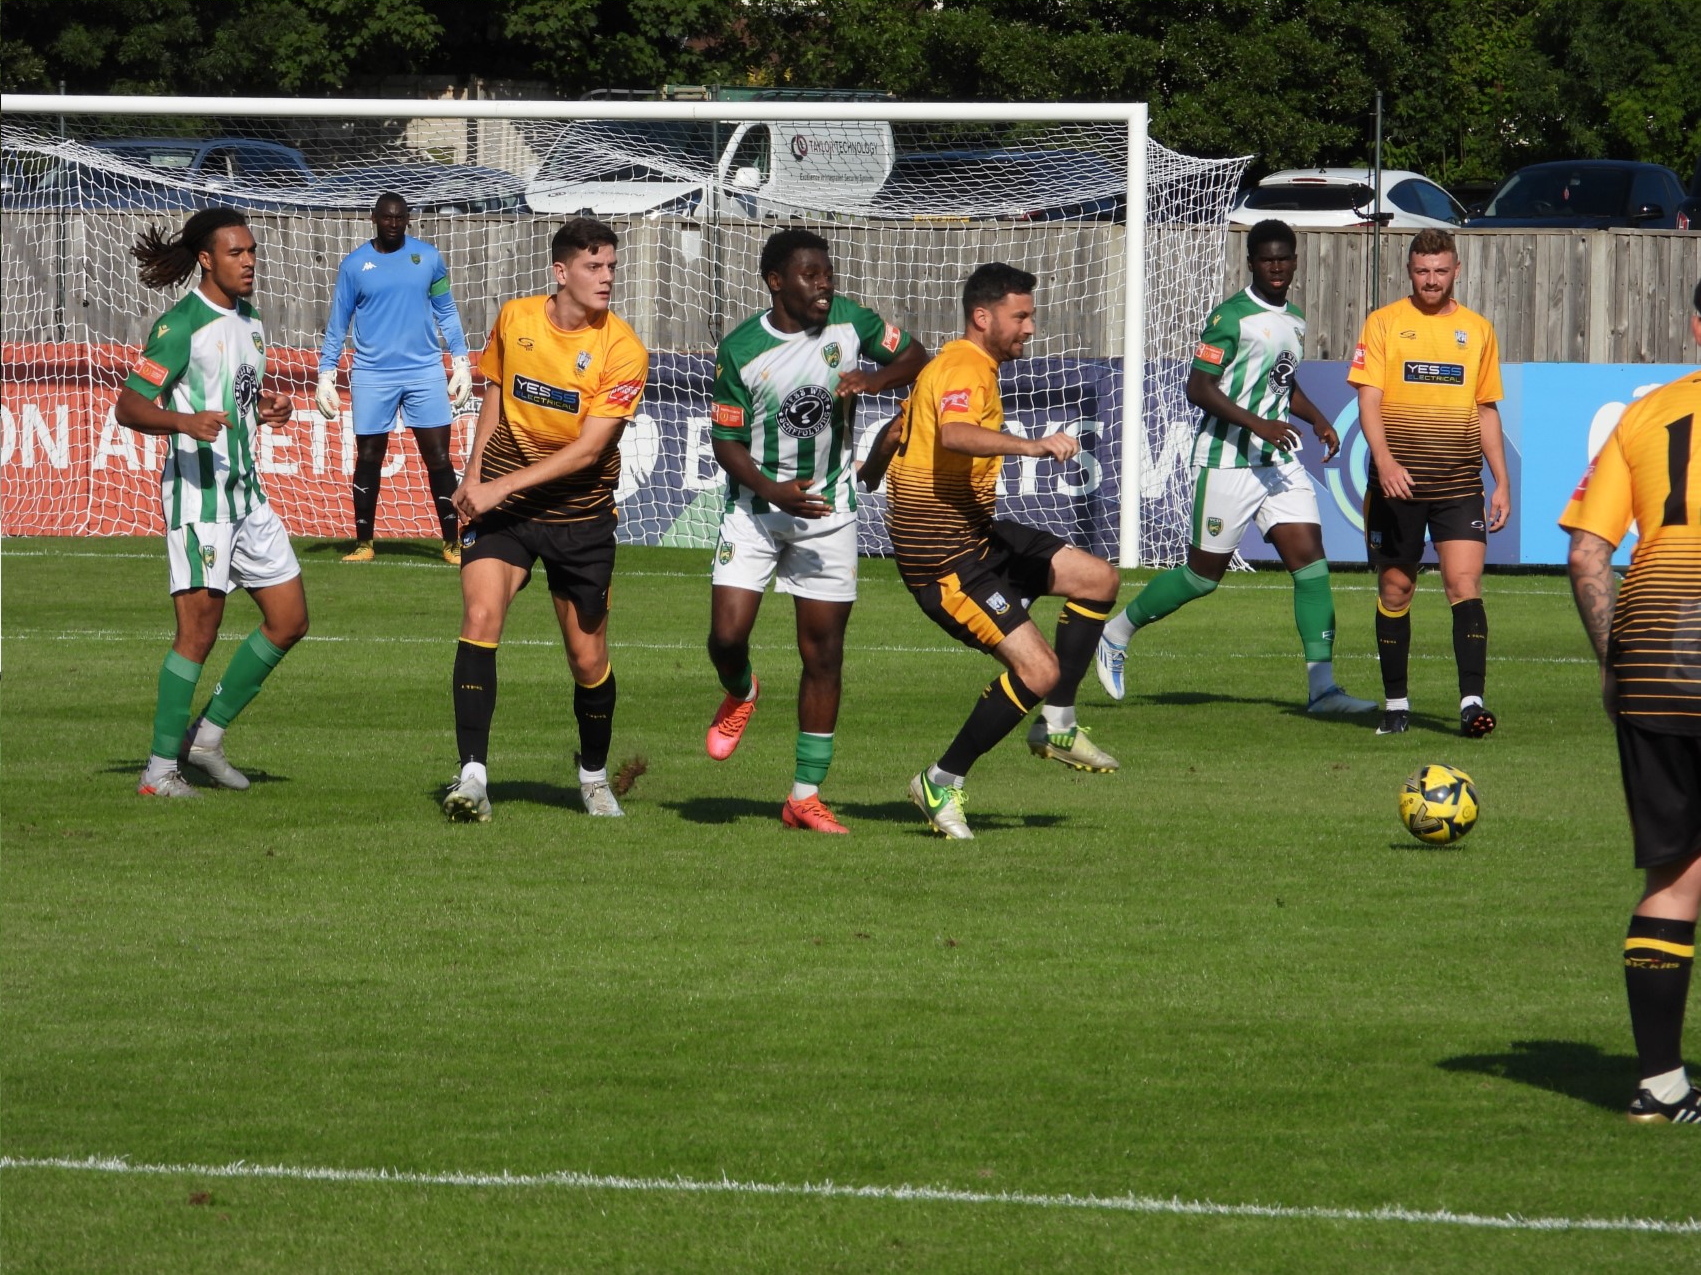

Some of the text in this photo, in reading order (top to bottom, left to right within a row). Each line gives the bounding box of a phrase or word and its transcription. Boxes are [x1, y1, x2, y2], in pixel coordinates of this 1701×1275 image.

[835, 140, 878, 155] TECHNOLOGY
[1407, 364, 1463, 376] YESSS
[1407, 375, 1461, 384] ELECTRICAL
[515, 378, 578, 404] YESSS
[515, 390, 575, 411] ELECTRICAL
